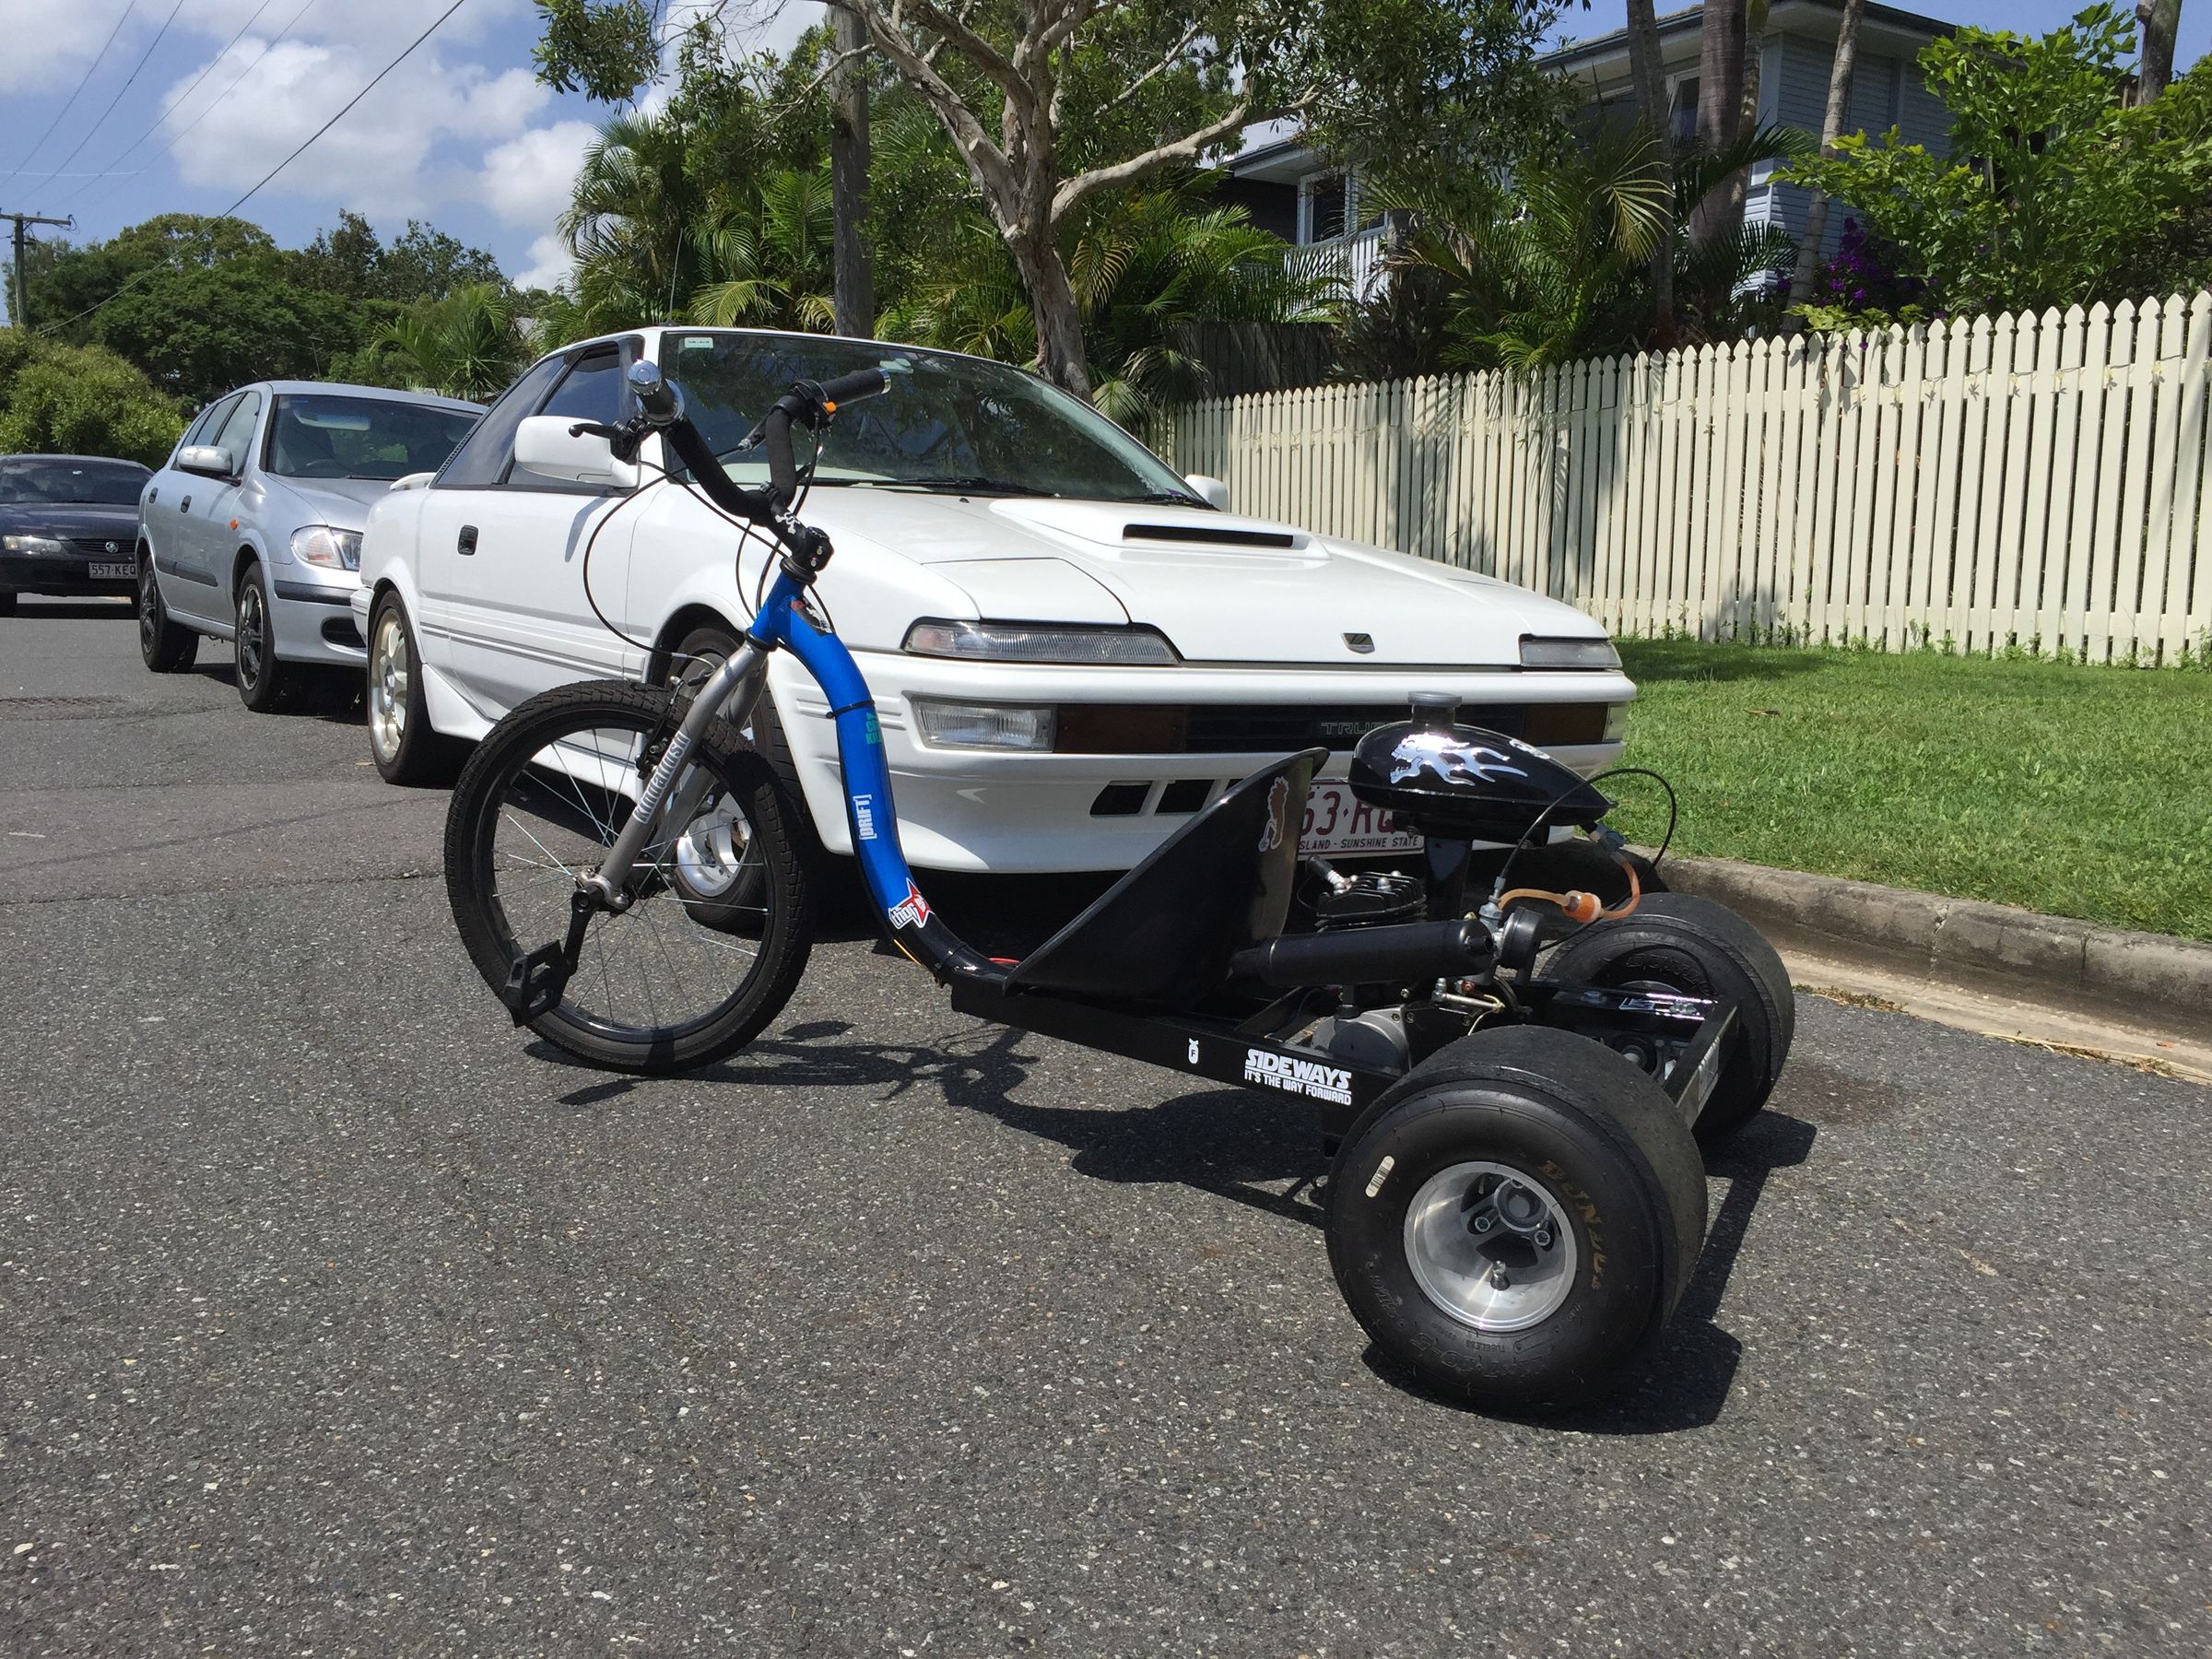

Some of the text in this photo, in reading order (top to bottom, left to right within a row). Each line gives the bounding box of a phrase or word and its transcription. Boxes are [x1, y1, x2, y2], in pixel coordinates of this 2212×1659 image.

[1321, 722, 1384, 735] TRU
[1340, 837, 1388, 849] SUNSHINE
[1392, 836, 1418, 847] STATE
[1245, 1049, 1352, 1089] SIDEWAYS
[1244, 1069, 1352, 1106] IT'S THE WAY FORWARD
